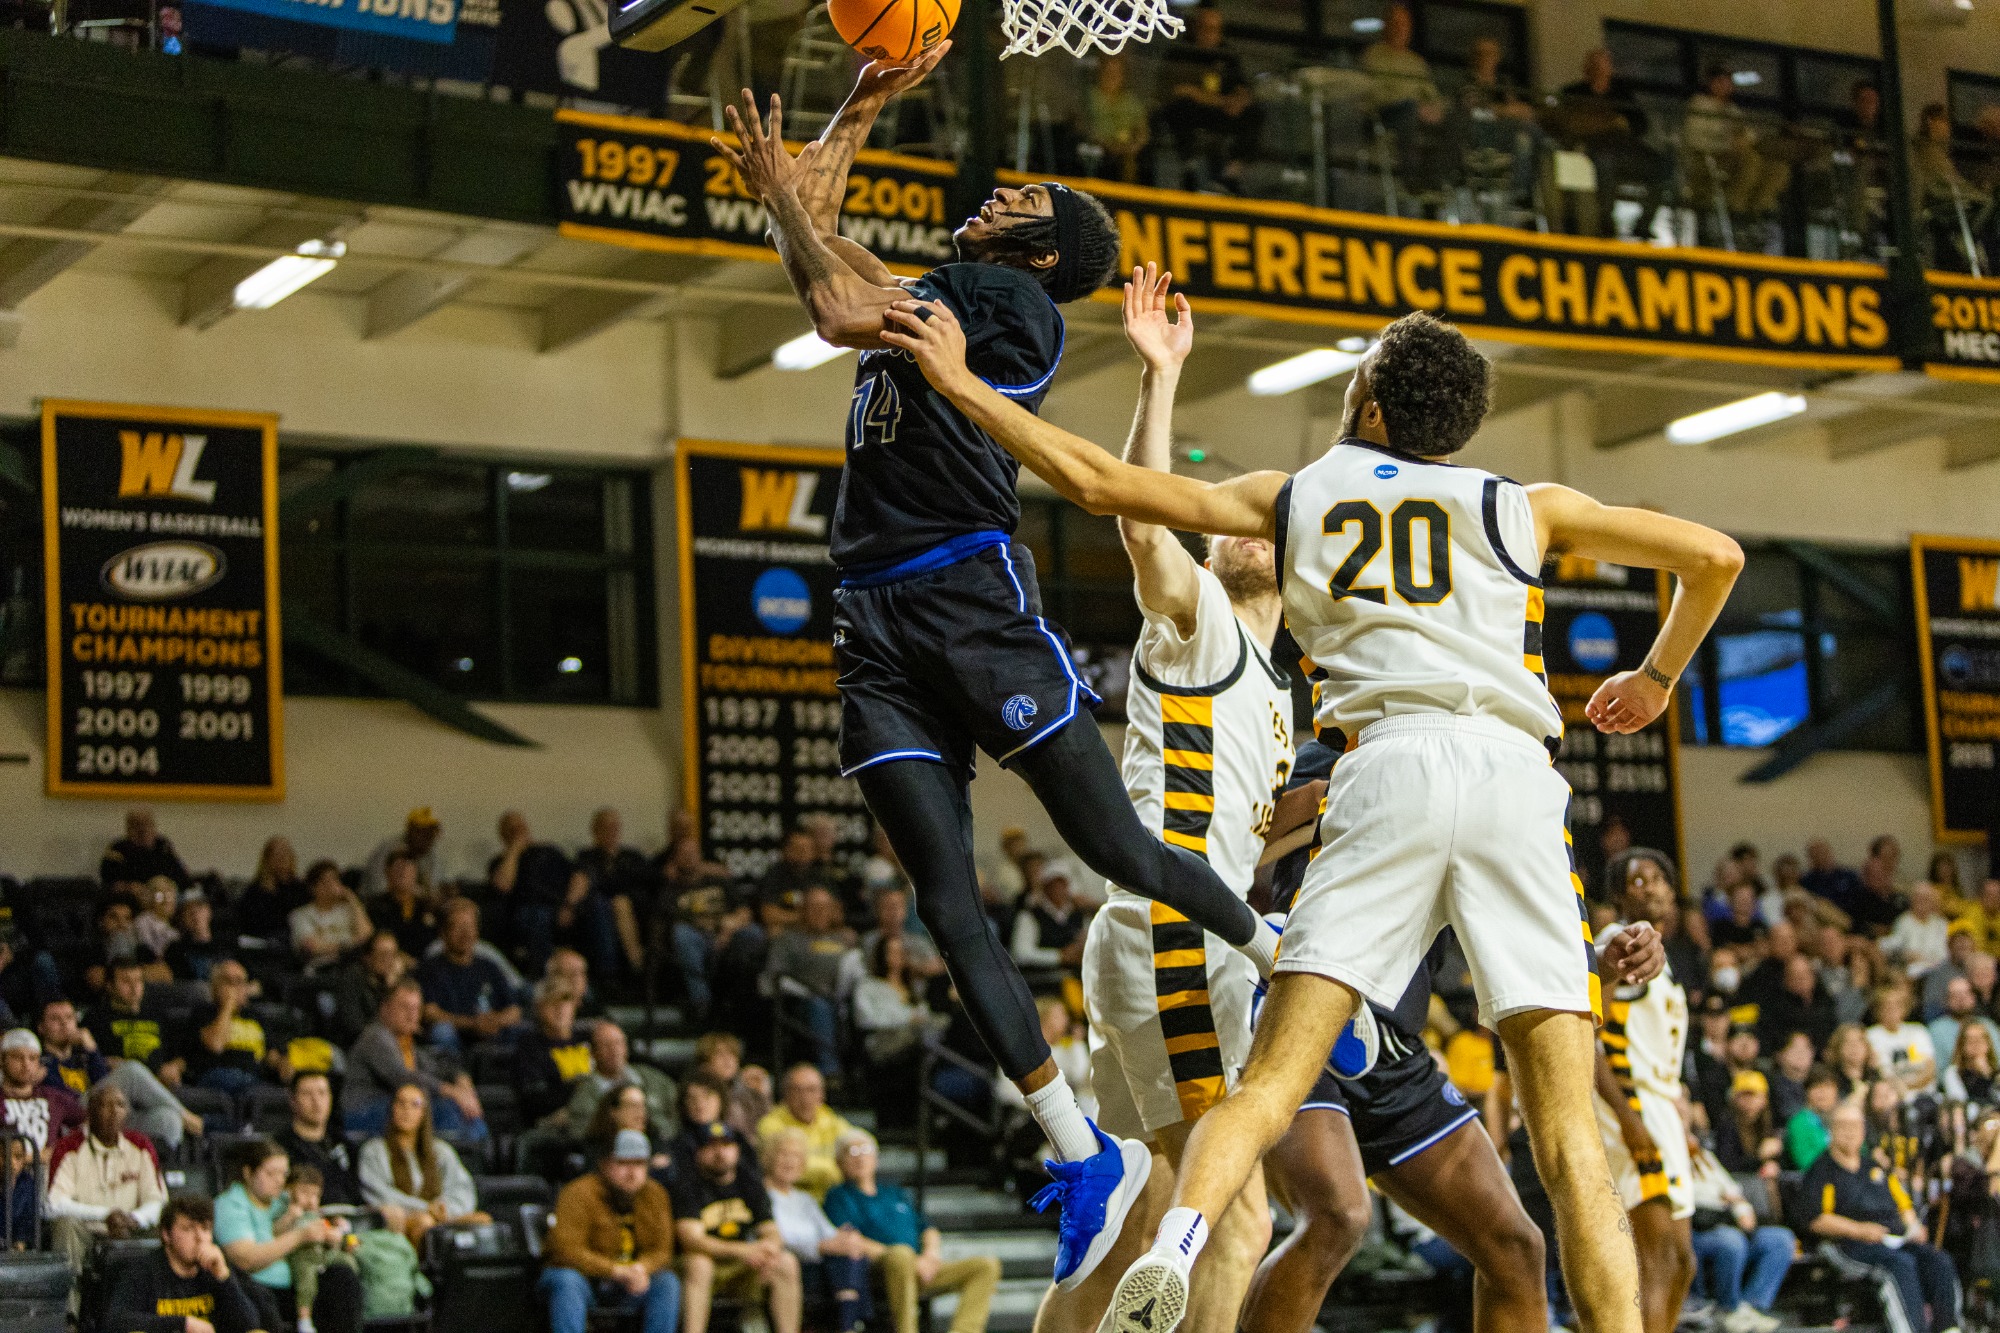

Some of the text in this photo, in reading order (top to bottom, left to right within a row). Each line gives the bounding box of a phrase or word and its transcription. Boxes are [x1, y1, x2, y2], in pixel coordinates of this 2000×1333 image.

[576, 139, 679, 188] 1997
[567, 180, 687, 227] WVIAC
[844, 175, 945, 224] 2001
[841, 214, 952, 260] WVIAC
[1116, 210, 1889, 349] NFERENCE CHAMPIONS
[851, 370, 903, 450] 14
[118, 430, 217, 503] WL
[61, 506, 263, 539] WOMEN'S BASKETBALL
[739, 466, 828, 536] WL
[1321, 497, 1454, 607] 20
[70, 603, 263, 637] TOURNAMENT
[72, 635, 262, 668] CHAMPIONS
[82, 671, 153, 699] 1997
[75, 707, 254, 740] 2000 2001
[77, 745, 160, 775] 2004
